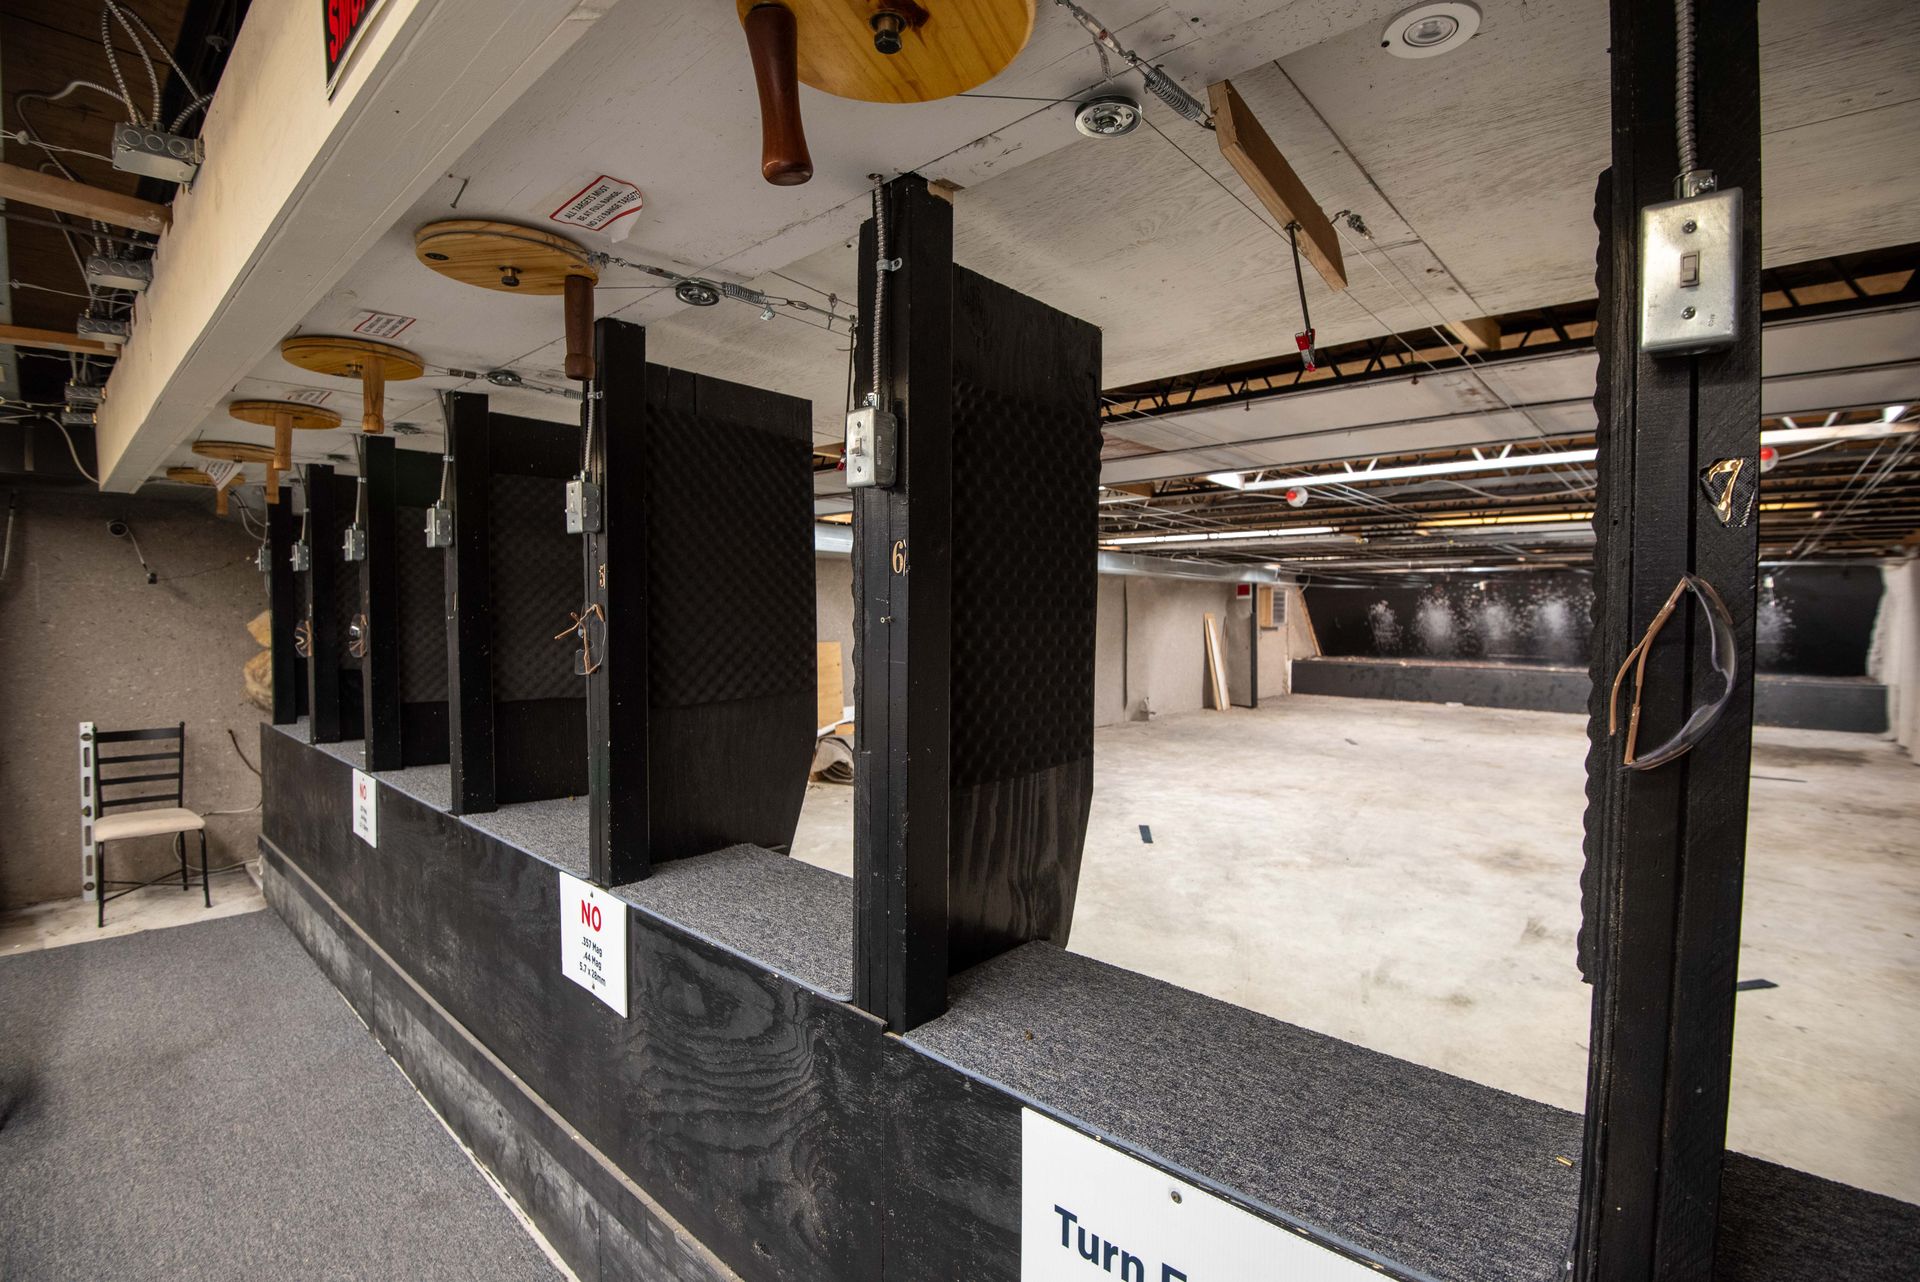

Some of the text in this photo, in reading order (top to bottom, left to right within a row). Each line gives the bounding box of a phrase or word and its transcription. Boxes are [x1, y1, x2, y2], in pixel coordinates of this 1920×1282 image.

[564, 185, 610, 219] ALL TARGETS MUST
[1708, 459, 1743, 522] 7
[892, 540, 904, 574] 6
[581, 899, 602, 932] NO
[581, 936, 603, 957] .357 Mag
[579, 961, 587, 974] 5.7
[591, 970, 606, 987] 28mm
[592, 956, 602, 971] Mag
[1054, 1204, 1144, 1282] Turn
